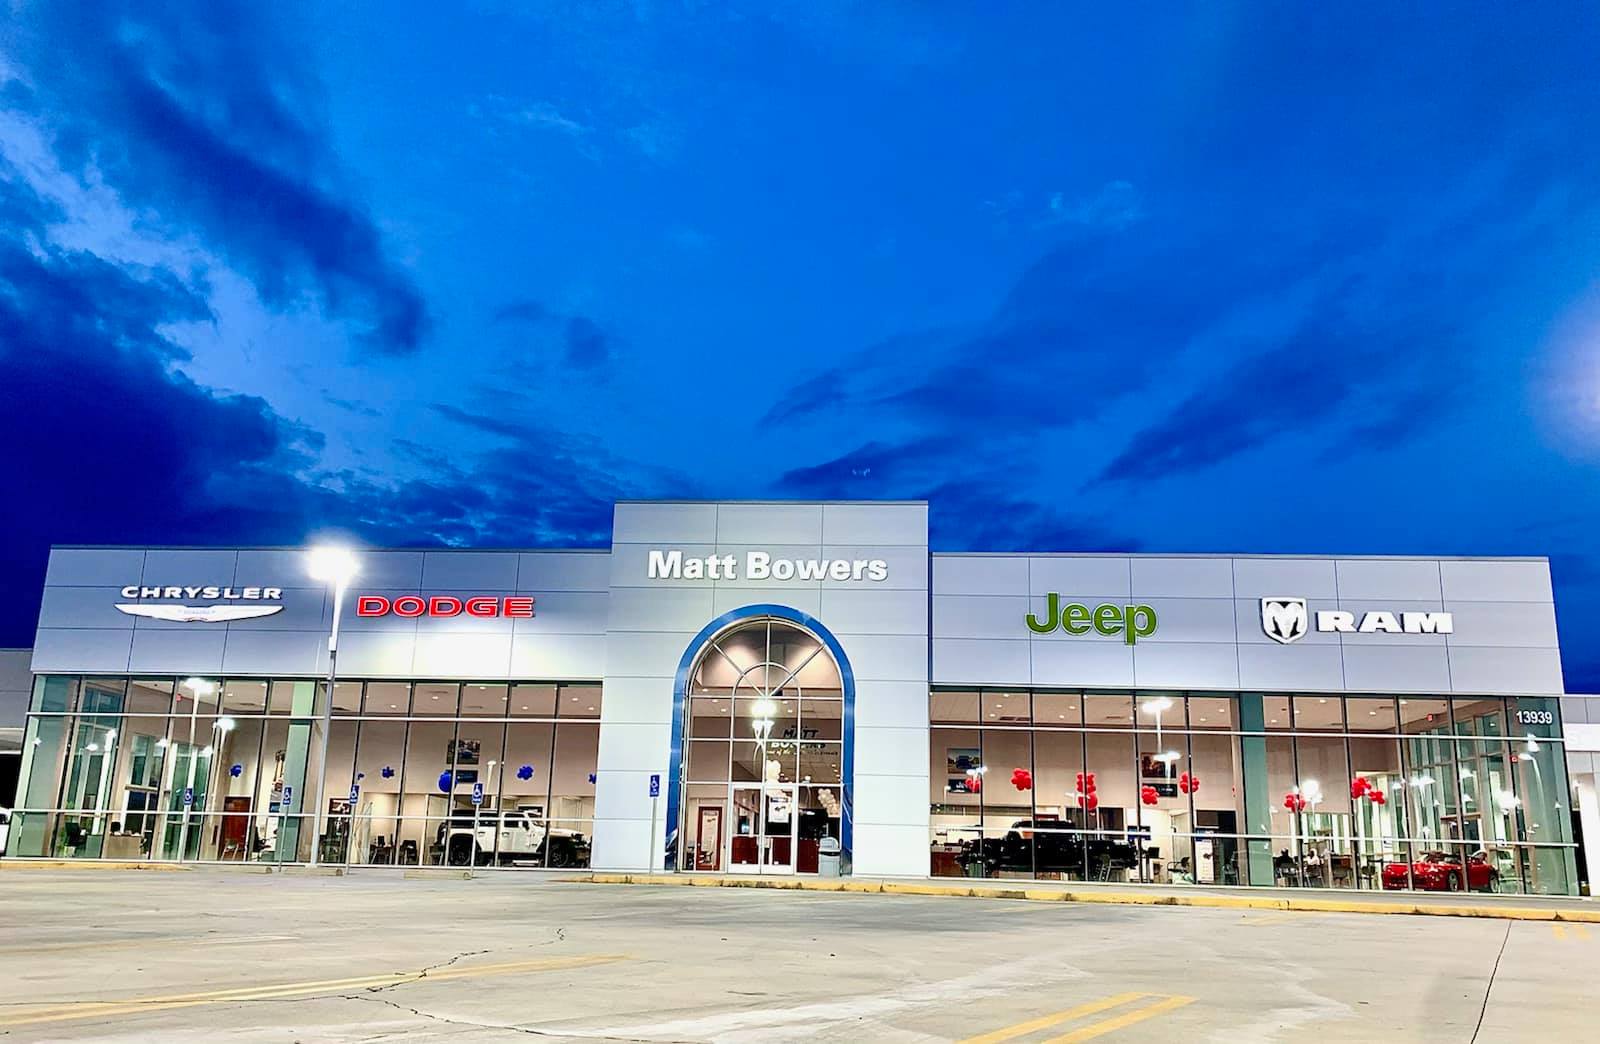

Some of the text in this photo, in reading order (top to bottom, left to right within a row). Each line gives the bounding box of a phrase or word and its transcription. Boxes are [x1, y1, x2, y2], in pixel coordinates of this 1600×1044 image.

[648, 550, 888, 581] Matt Bowers
[121, 586, 282, 599] CHRYSLER
[357, 596, 534, 617] DODGE
[1025, 592, 1158, 646] Jeep
[1315, 611, 1453, 634] RAM
[1516, 711, 1553, 724] 13939
